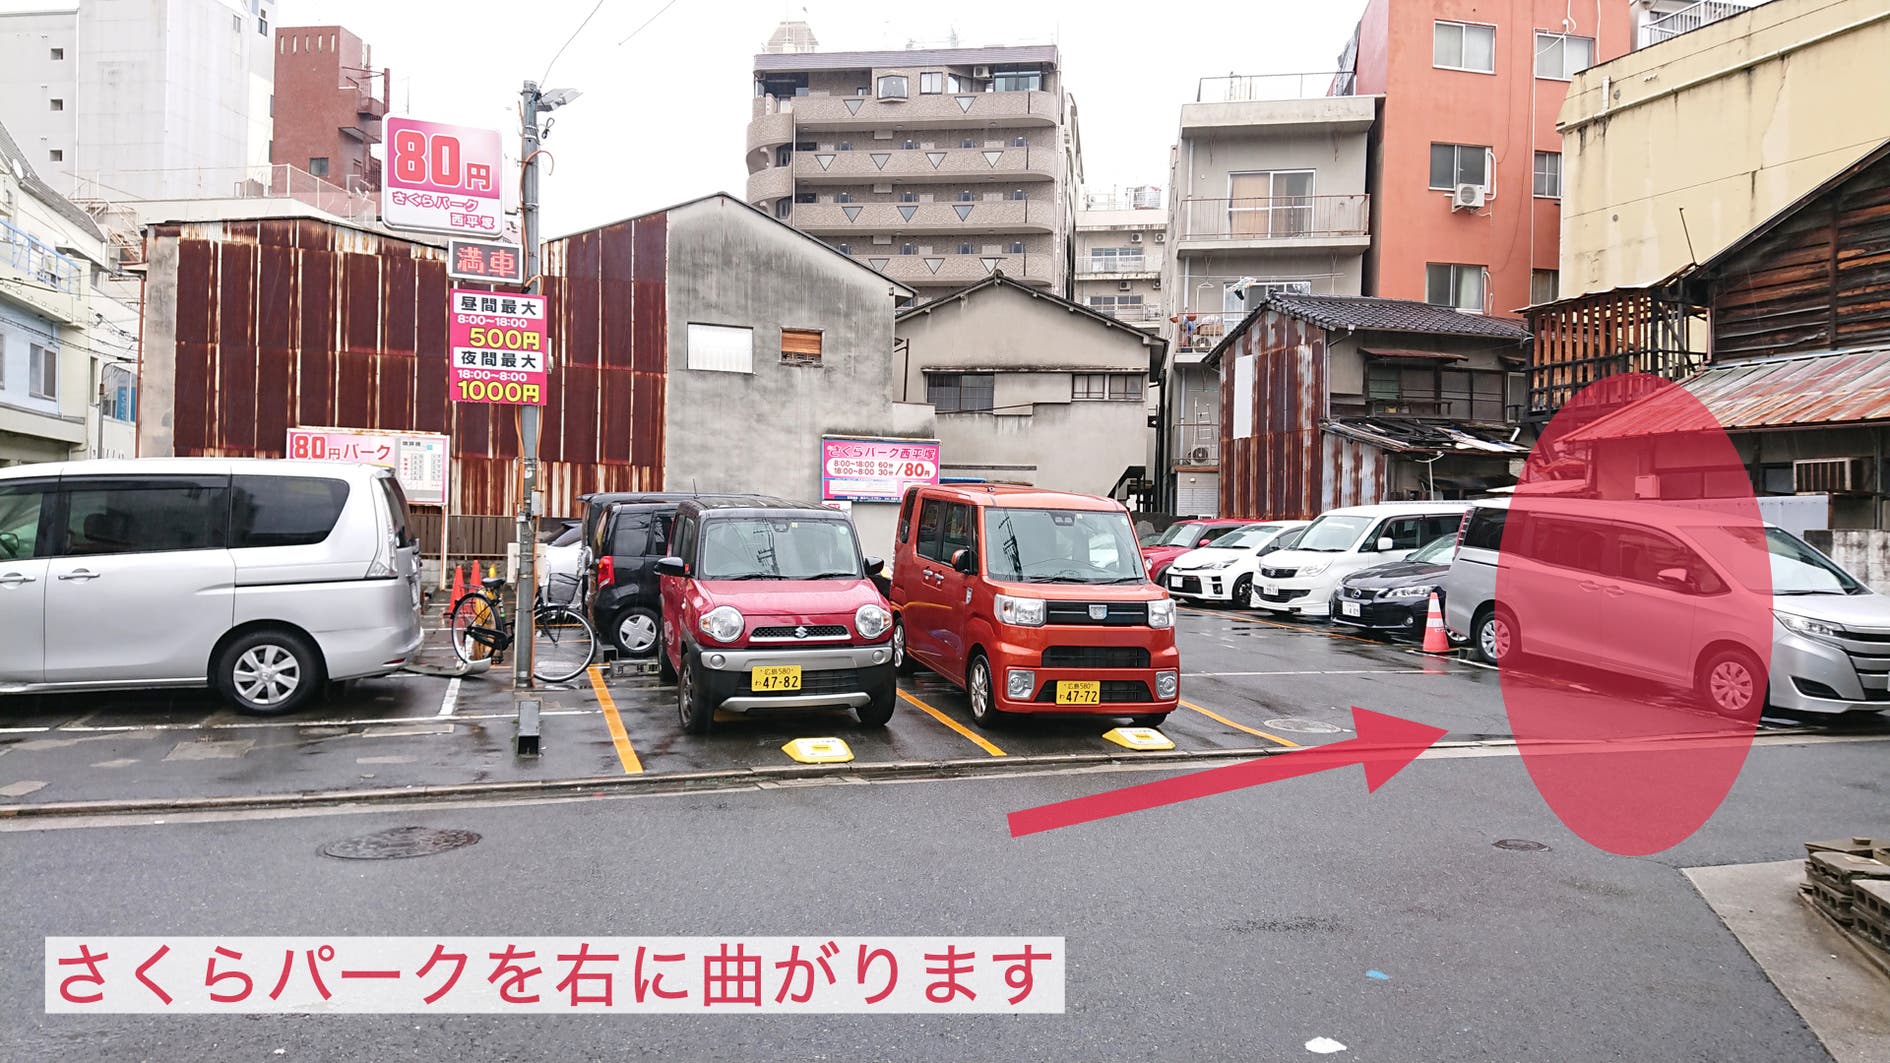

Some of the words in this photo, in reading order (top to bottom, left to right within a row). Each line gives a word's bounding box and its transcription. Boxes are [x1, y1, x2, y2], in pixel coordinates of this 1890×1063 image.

[394, 129, 492, 191] 80円
[392, 191, 479, 213] さくらパーク
[450, 212, 495, 230] 西平塚
[456, 246, 517, 277] 満車
[461, 295, 537, 316] 昼間最大
[469, 327, 541, 351] 500円
[461, 350, 537, 369] 夜間最大
[457, 380, 541, 403] 1000円
[294, 434, 391, 460] 80円パーク
[829, 445, 936, 460] さくらパーク西平塚
[763, 676, 798, 689] 47-82
[1066, 691, 1097, 702] 47-72
